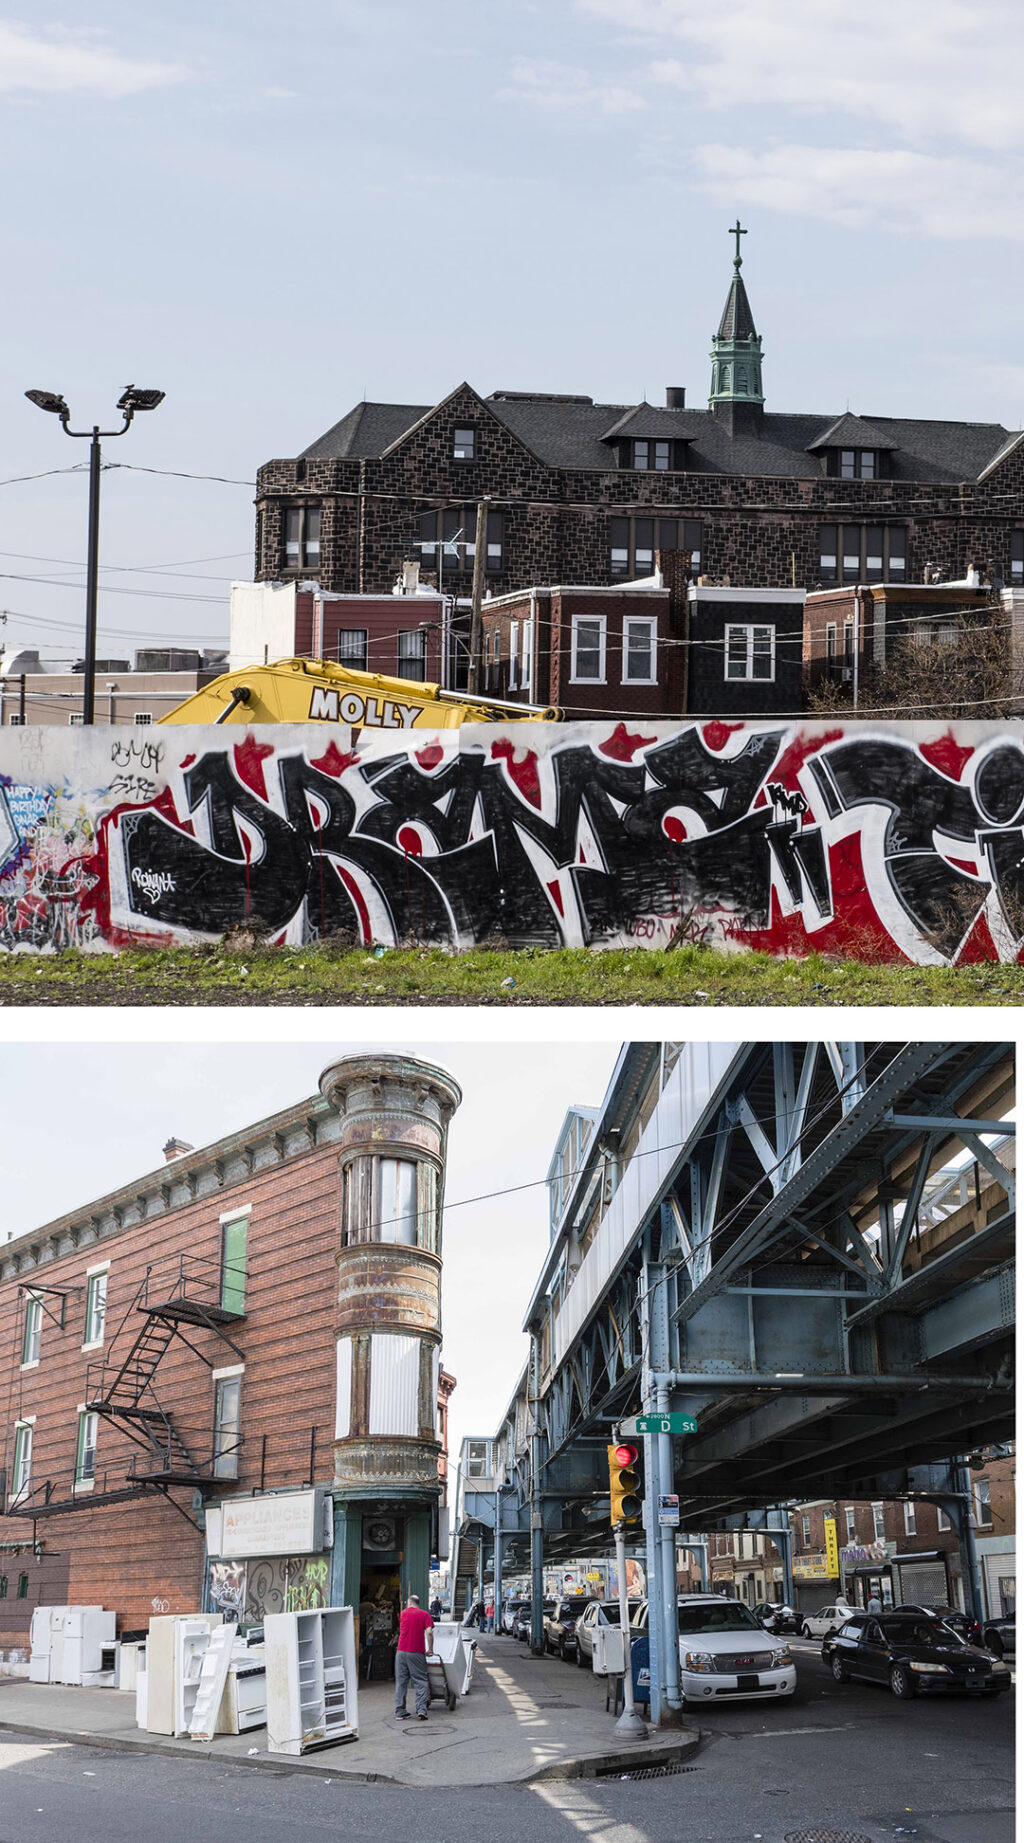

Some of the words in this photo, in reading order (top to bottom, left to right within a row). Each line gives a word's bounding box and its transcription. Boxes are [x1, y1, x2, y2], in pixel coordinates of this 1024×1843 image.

[309, 686, 424, 728] MOLLY
[10, 798, 51, 815] BIRTHDAY
[661, 1420, 671, 1432] D
[682, 1421, 695, 1431] St
